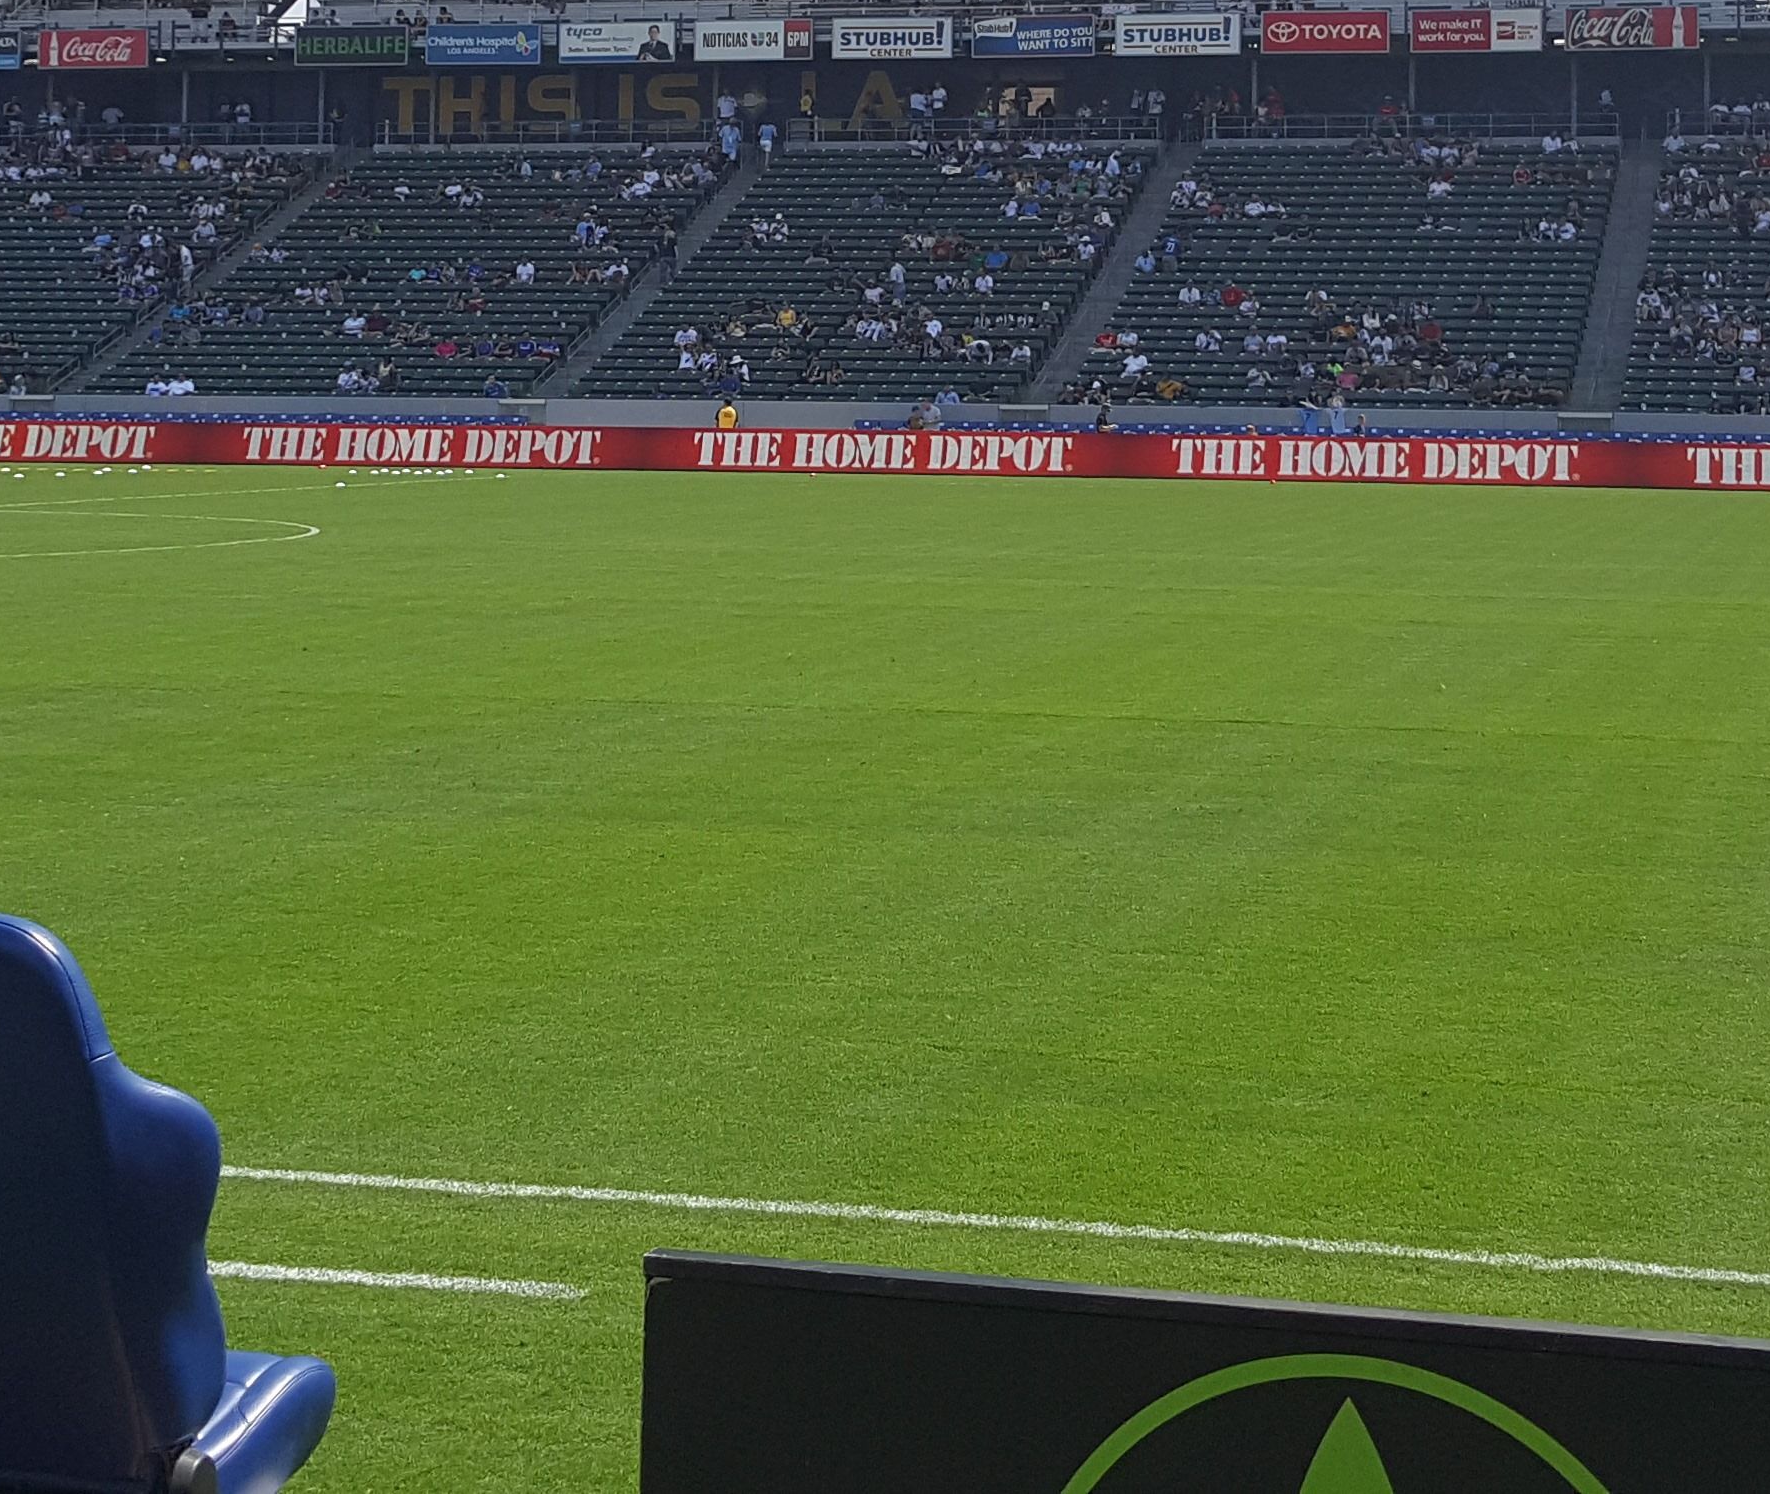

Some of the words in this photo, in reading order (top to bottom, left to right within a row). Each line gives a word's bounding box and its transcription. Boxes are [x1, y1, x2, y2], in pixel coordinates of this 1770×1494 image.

[565, 26, 603, 39] tyco
[1123, 16, 1231, 42] STUBHUB!
[1302, 23, 1382, 40] TOYOTA
[1419, 20, 1437, 30] We
[1439, 19, 1469, 30] make
[1471, 19, 1483, 29] IT
[1568, 8, 1654, 49] Coca-Cola
[702, 32, 749, 47] NOTICIAS
[765, 31, 779, 47] 34
[787, 31, 809, 47] 6PM
[840, 20, 944, 46] STUBHUB!
[1016, 28, 1052, 40] WHERE
[1053, 28, 1070, 38] DO
[1072, 26, 1093, 37] YOU
[1418, 32, 1445, 42] work
[1446, 32, 1463, 42] for
[1463, 34, 1485, 44] you.
[299, 36, 406, 55] HERBALIFE
[428, 36, 475, 47] Children's
[476, 36, 517, 49] Hospital
[1017, 39, 1051, 51] WANT
[1053, 39, 1069, 49] TO
[1070, 37, 1093, 48] SIT?
[1154, 43, 1198, 54] CENTER
[447, 47, 462, 55] LOS
[869, 47, 912, 58] CENTER
[383, 74, 581, 134] THIS
[619, 73, 699, 131] IS
[24, 424, 157, 459] DEPOT
[243, 427, 326, 462] THE
[332, 428, 456, 463] HOME
[464, 429, 602, 465] DEPOT
[695, 432, 781, 468] THE
[791, 433, 918, 469] HOME
[927, 436, 1073, 472] DEPOT
[1172, 438, 1269, 474] THE
[1277, 439, 1410, 477] HOME
[1424, 442, 1579, 481] DEPOT
